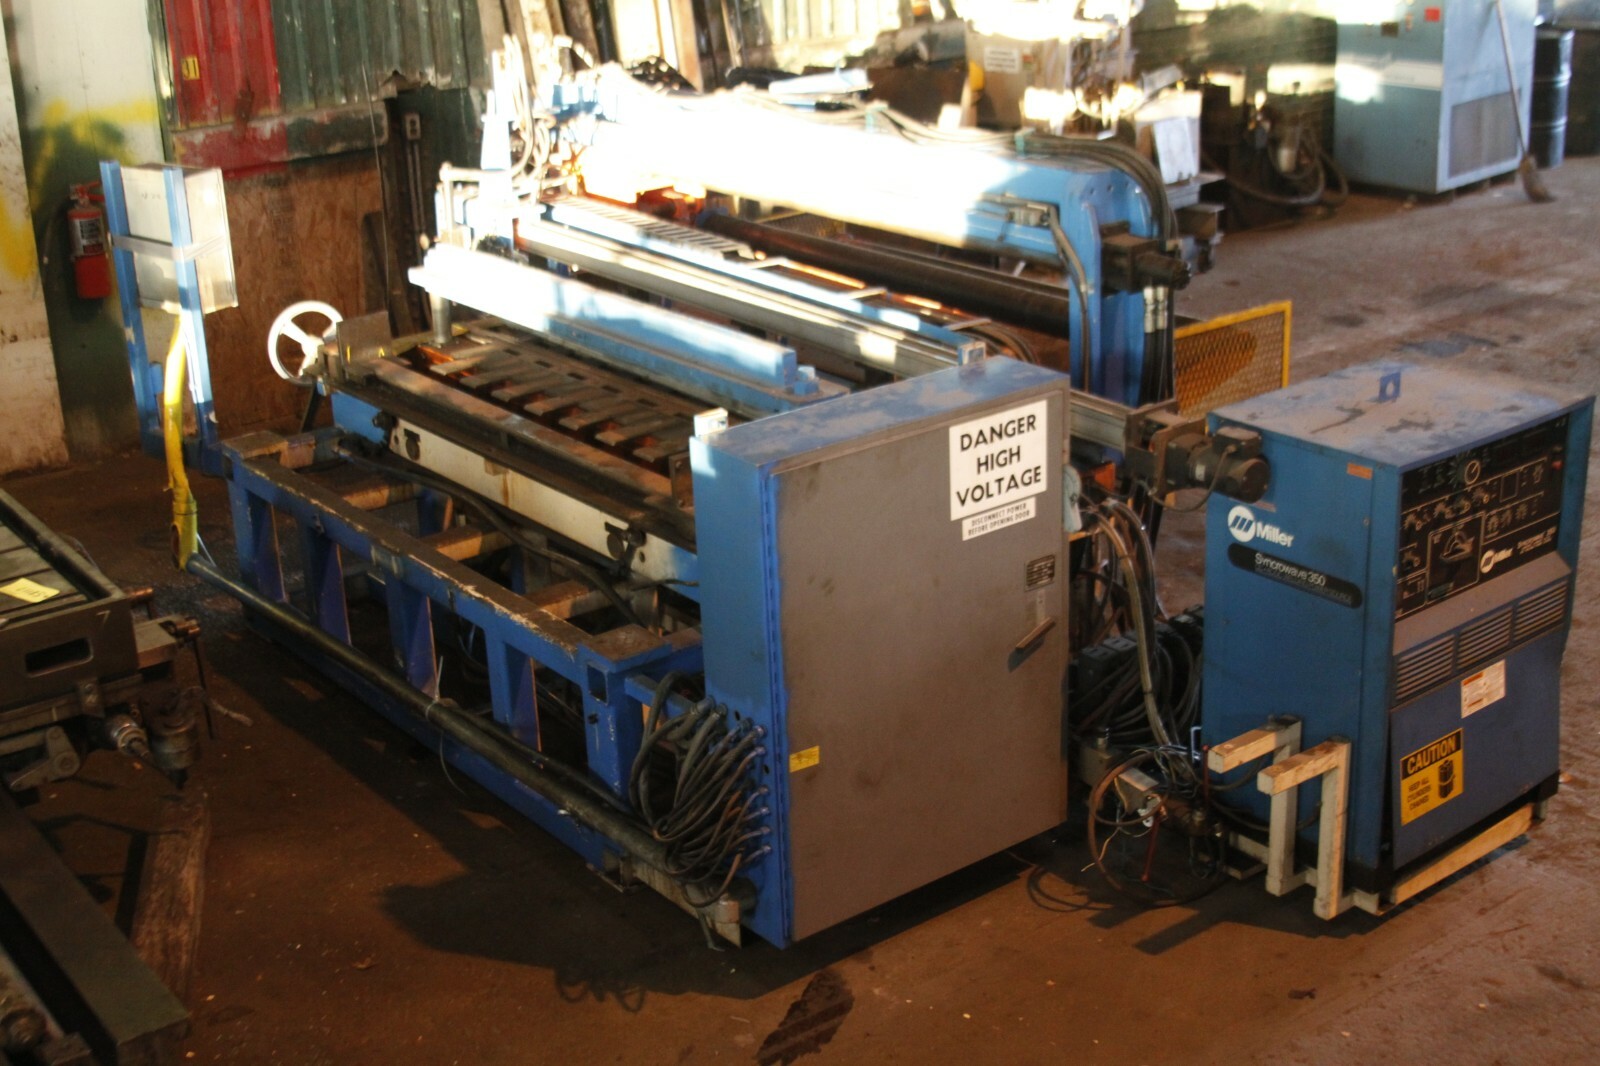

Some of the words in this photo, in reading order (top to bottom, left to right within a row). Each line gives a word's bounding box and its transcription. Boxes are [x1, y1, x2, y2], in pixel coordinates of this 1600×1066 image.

[960, 414, 1036, 452] DANGER
[976, 445, 1021, 475] HIGH
[956, 465, 1042, 507] VOLTAGE
[968, 523, 988, 536] BEFORE
[989, 515, 1014, 528] OPENING
[1014, 509, 1030, 521] DOOR
[971, 509, 1005, 527] DISCONNECT
[1006, 502, 1027, 514] POWER
[1256, 521, 1295, 547] Miller
[1307, 571, 1327, 587] 350
[1406, 734, 1457, 775] CAUTION
